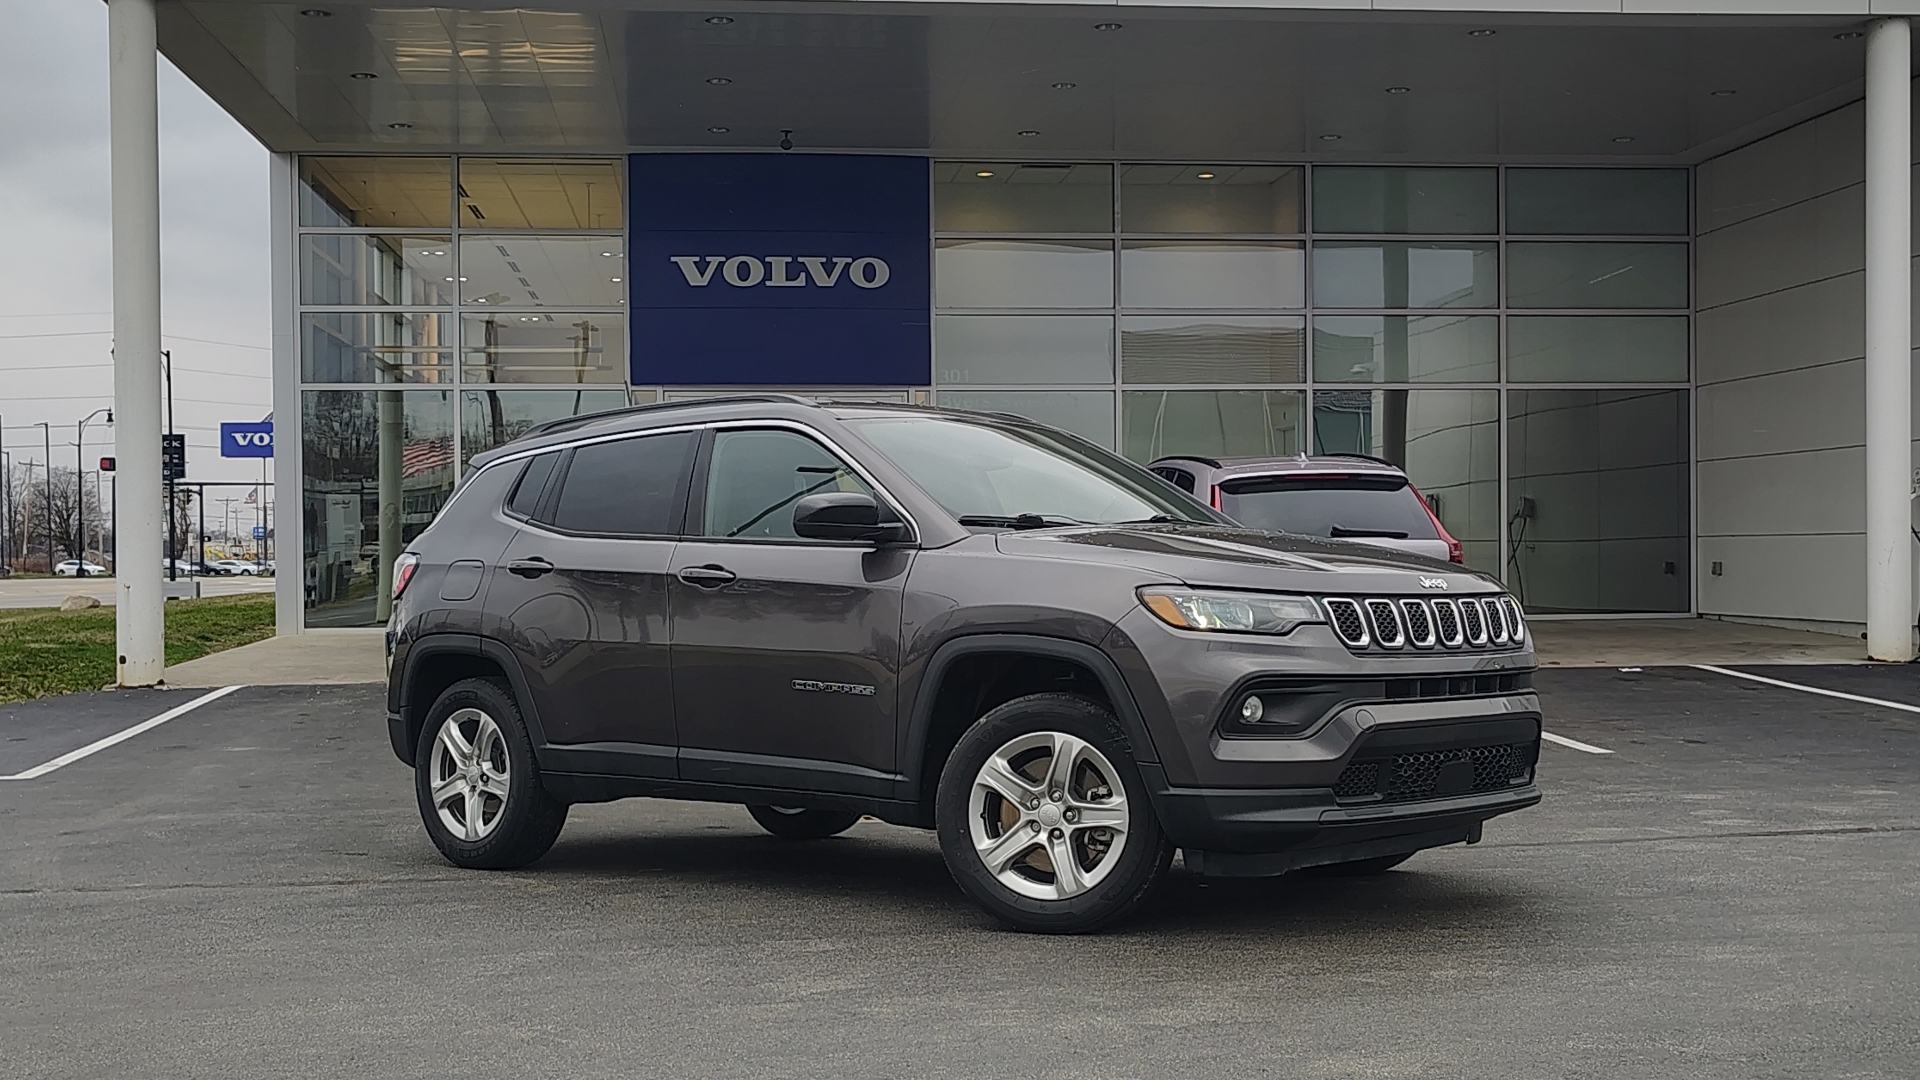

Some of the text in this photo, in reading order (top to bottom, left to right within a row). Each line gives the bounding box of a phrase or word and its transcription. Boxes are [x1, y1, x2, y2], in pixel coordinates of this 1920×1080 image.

[670, 256, 890, 288] VOLVO
[940, 368, 970, 383] 301
[231, 432, 274, 446] VO
[1418, 575, 1448, 591] Jeep
